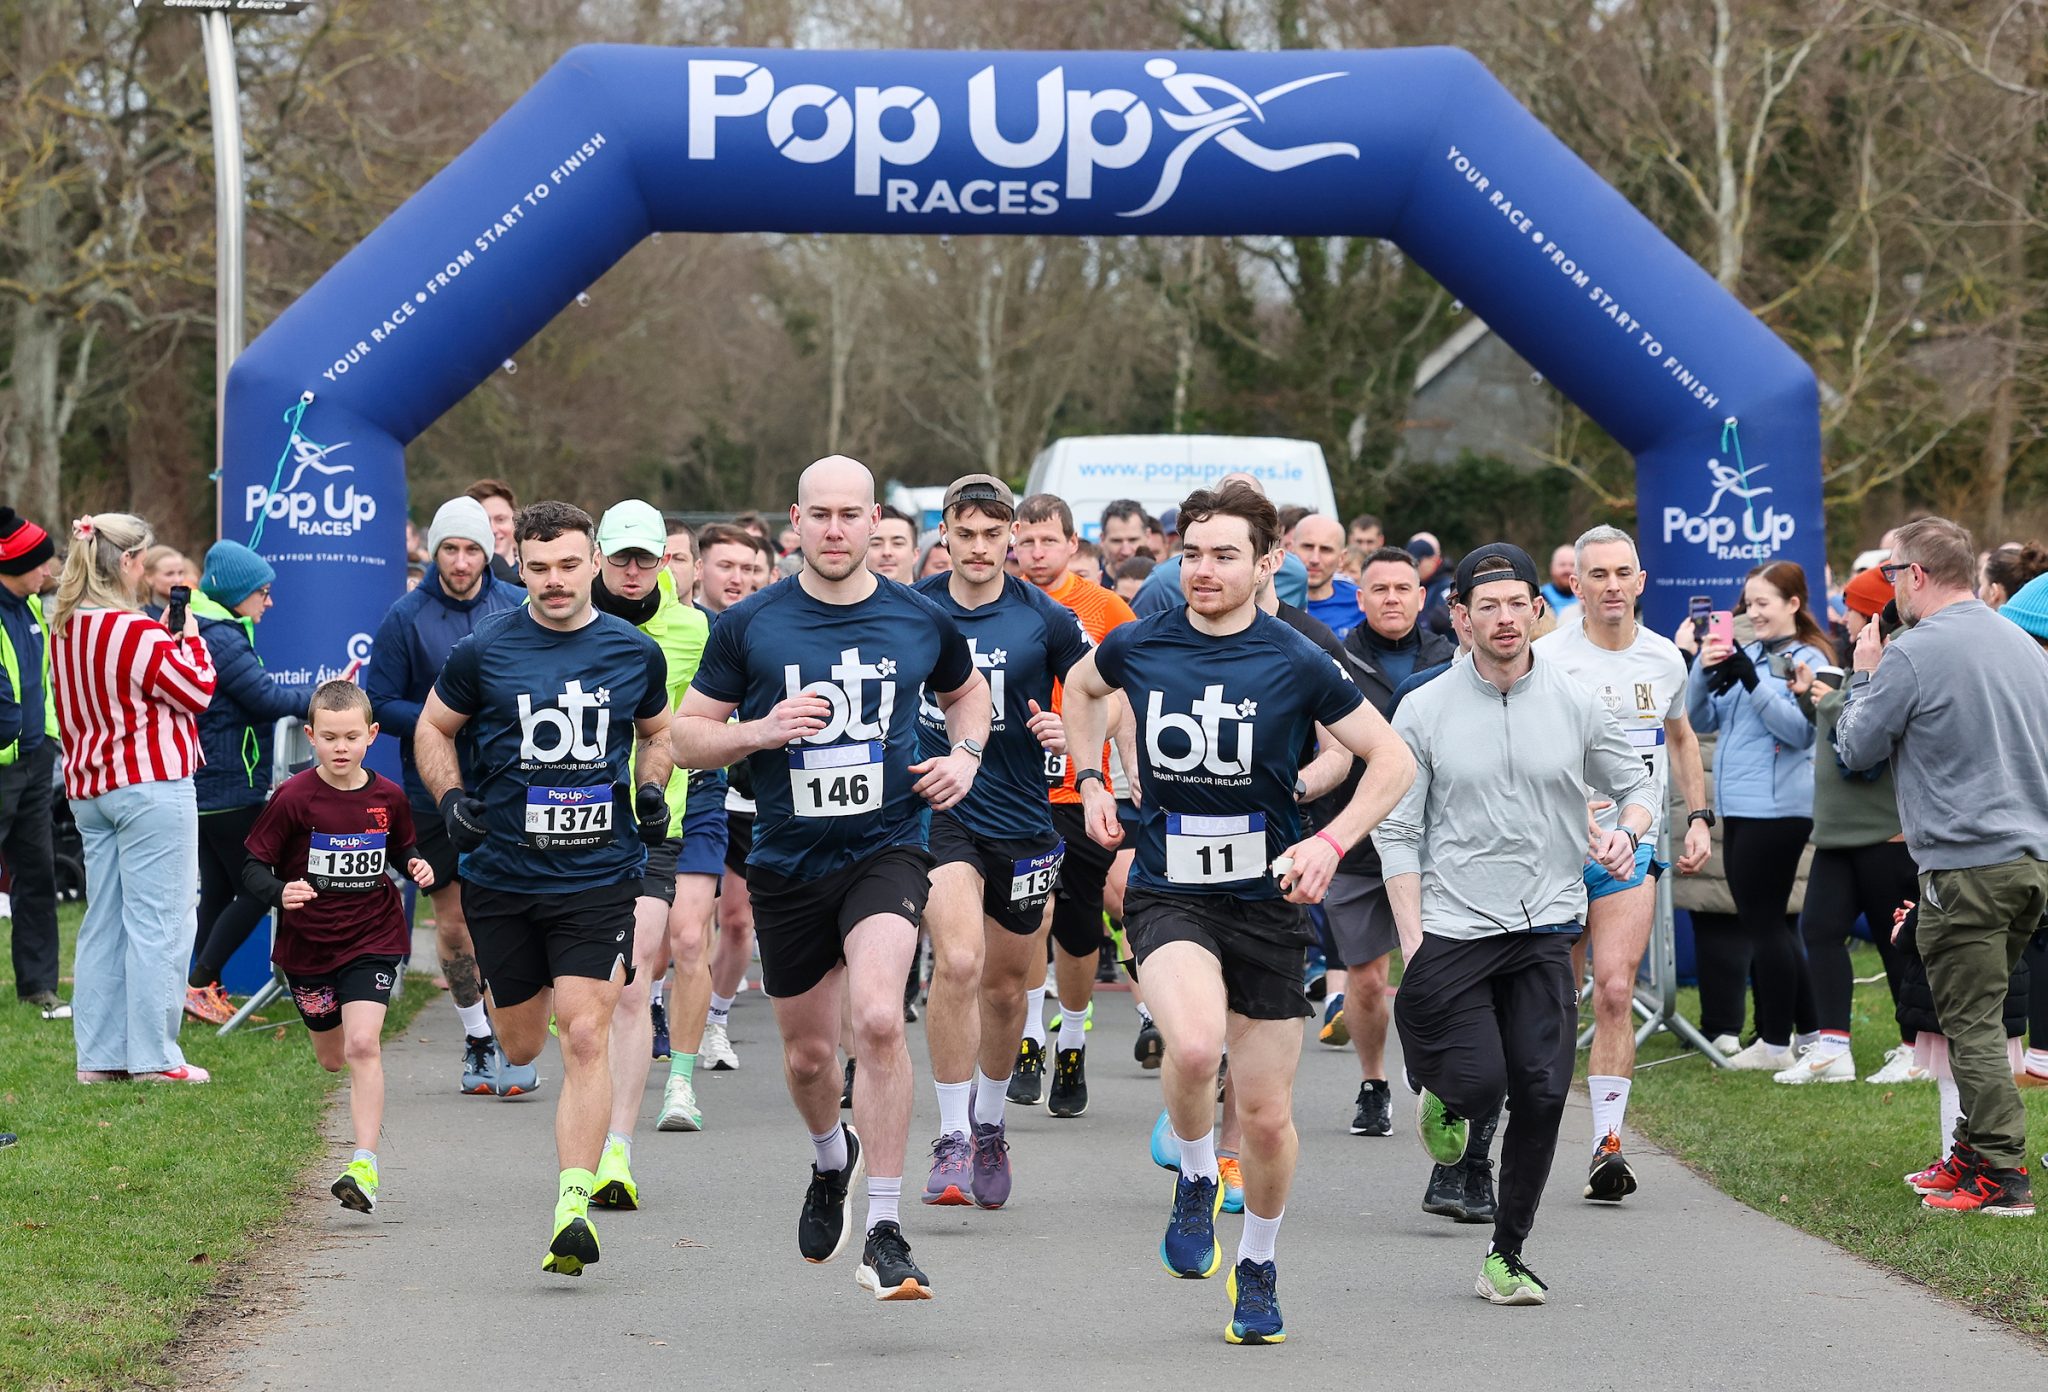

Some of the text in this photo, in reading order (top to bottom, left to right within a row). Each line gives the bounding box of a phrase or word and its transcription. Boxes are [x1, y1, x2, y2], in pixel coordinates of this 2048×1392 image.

[688, 59, 1153, 200] Pop Up
[886, 179, 1060, 216] RACES
[322, 132, 606, 382] YOUR RACE FROM START TO FINISH
[1447, 146, 1720, 409] YOUR RACE FROM START TO FINISH
[245, 483, 377, 531] Pop Up
[298, 521, 353, 537] RACES
[1663, 505, 1796, 554] Pop Up
[286, 553, 313, 562] FROM
[316, 552, 344, 562] START
[346, 554, 359, 564] TO
[360, 556, 387, 566] FINISH
[1717, 543, 1772, 560] RACES
[784, 646, 896, 745] bti
[517, 679, 611, 763] bti
[1145, 683, 1256, 777] bti
[520, 760, 608, 771] BRAIN TUMOUR IRELAND
[1152, 769, 1253, 787] BRAIN TUMOUR IRELAND
[548, 789, 583, 803] Pop Up
[807, 773, 870, 808] 146
[543, 804, 608, 832] 1374
[329, 836, 360, 848] Pop Up
[551, 836, 601, 847] PEUGEOT
[325, 850, 382, 875] 1389
[1196, 843, 1234, 876] 11
[331, 880, 376, 888] PEUGEOT
